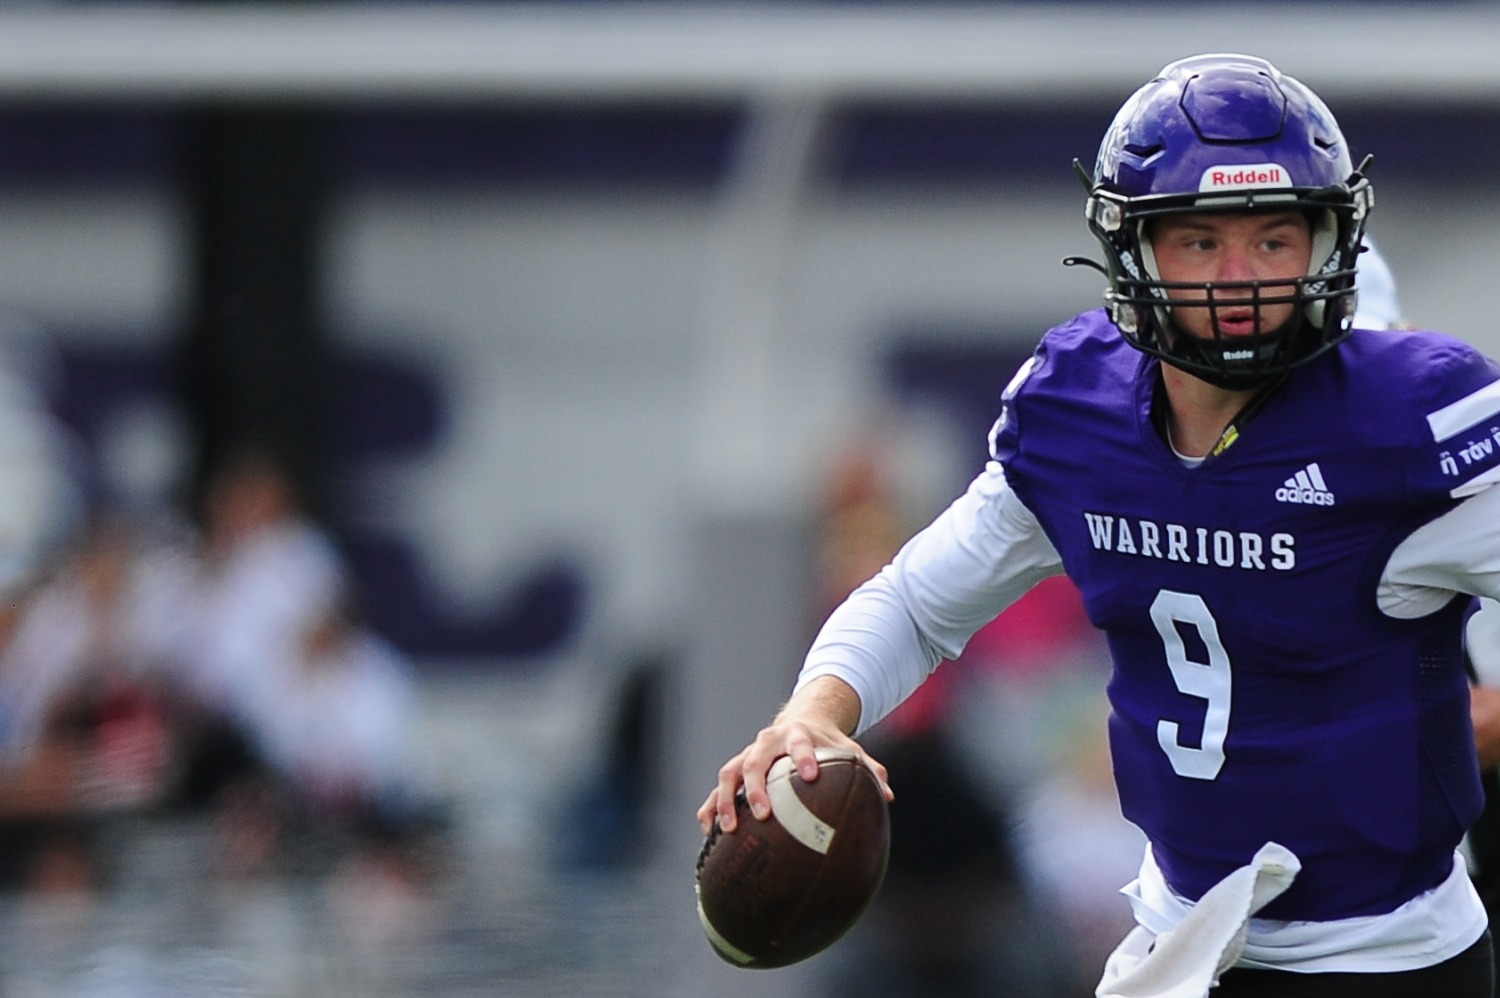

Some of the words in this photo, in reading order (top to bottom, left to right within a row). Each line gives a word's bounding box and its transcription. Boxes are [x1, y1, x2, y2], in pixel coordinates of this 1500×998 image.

[1212, 169, 1280, 186] Riddell
[1275, 487, 1335, 506] adidas
[1084, 512, 1296, 571] WARRIORS
[1149, 588, 1233, 780] 9
